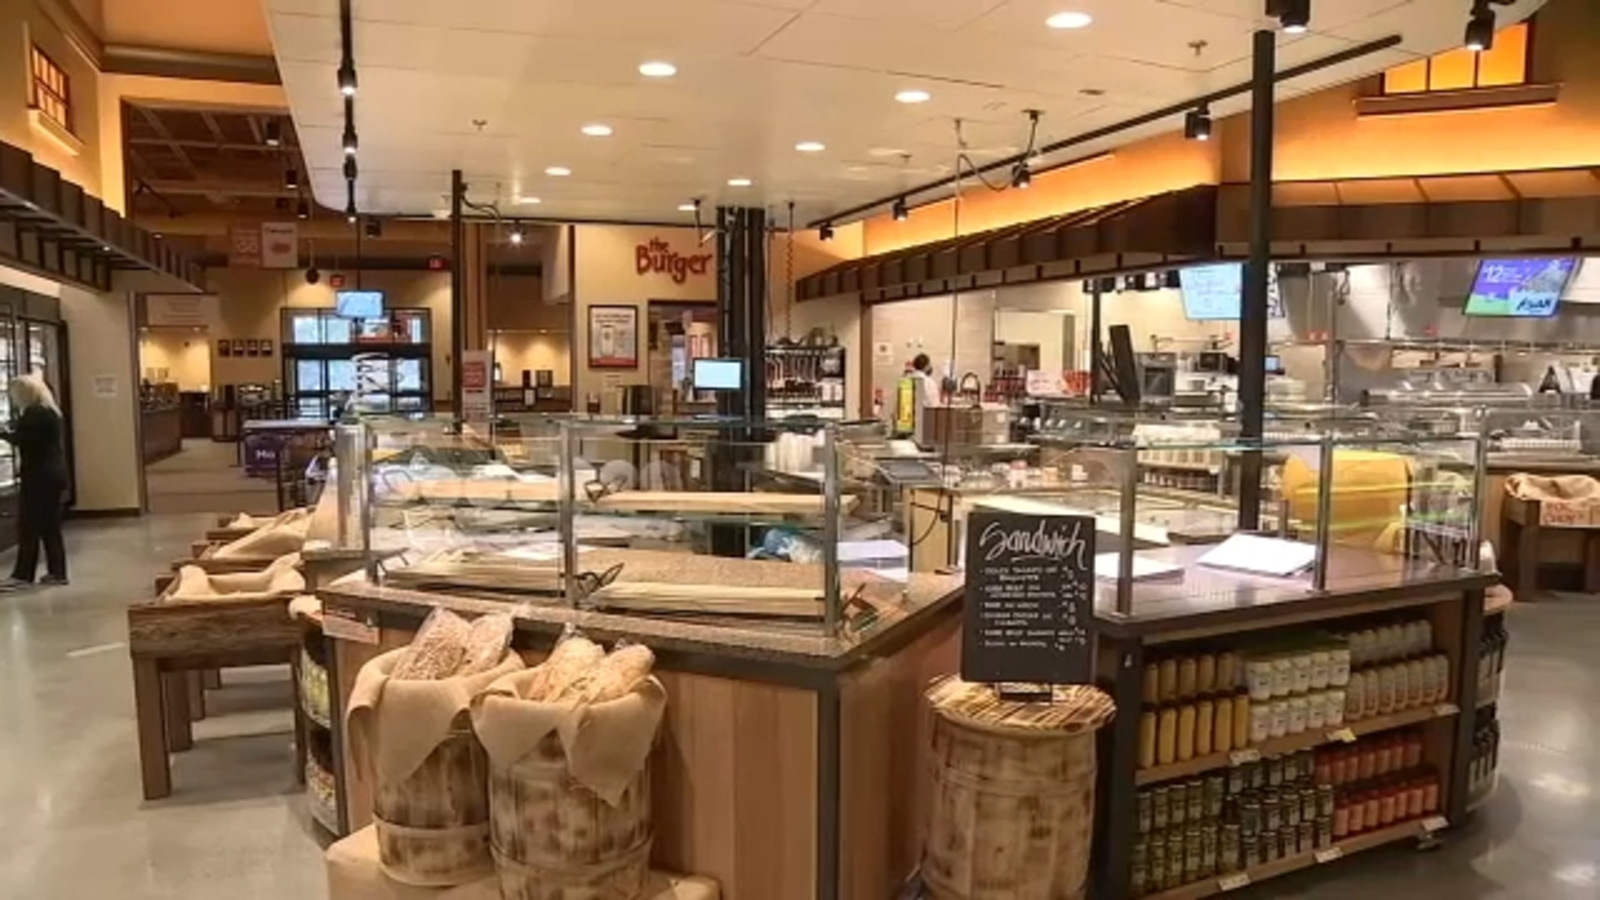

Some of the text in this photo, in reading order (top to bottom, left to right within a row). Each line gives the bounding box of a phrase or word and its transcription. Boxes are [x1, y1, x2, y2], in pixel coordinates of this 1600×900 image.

[635, 244, 713, 285] Burger
[649, 236, 669, 252] the
[978, 519, 1089, 571] Sandwich
